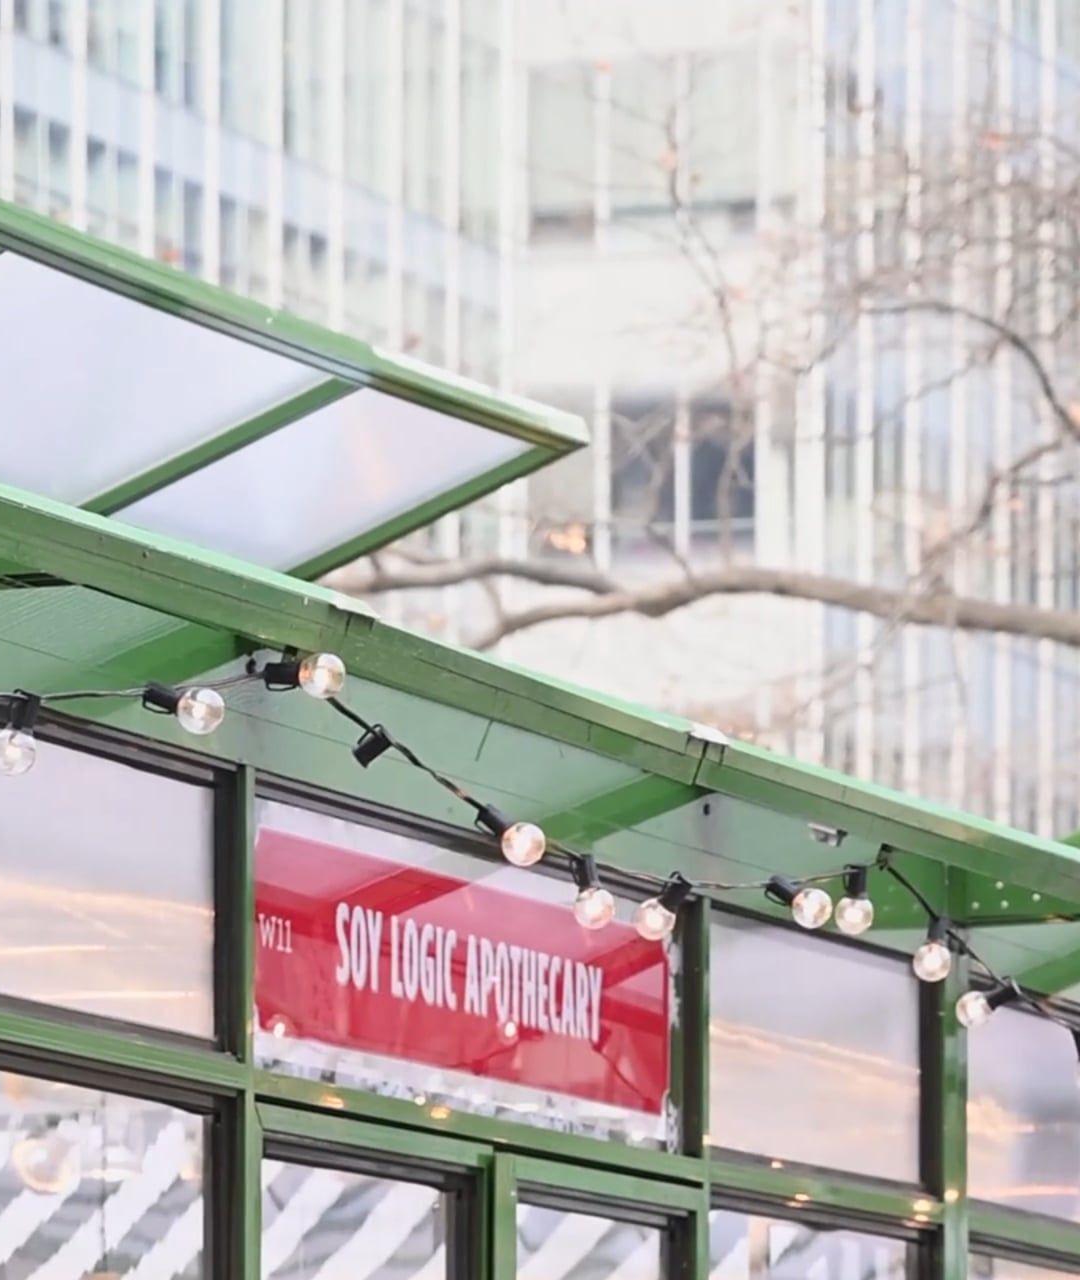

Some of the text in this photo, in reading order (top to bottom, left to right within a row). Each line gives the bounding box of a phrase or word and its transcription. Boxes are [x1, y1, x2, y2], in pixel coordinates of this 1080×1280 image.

[258, 913, 293, 953] W11
[335, 902, 603, 1042] SOY LOGIC APOTHECARY
